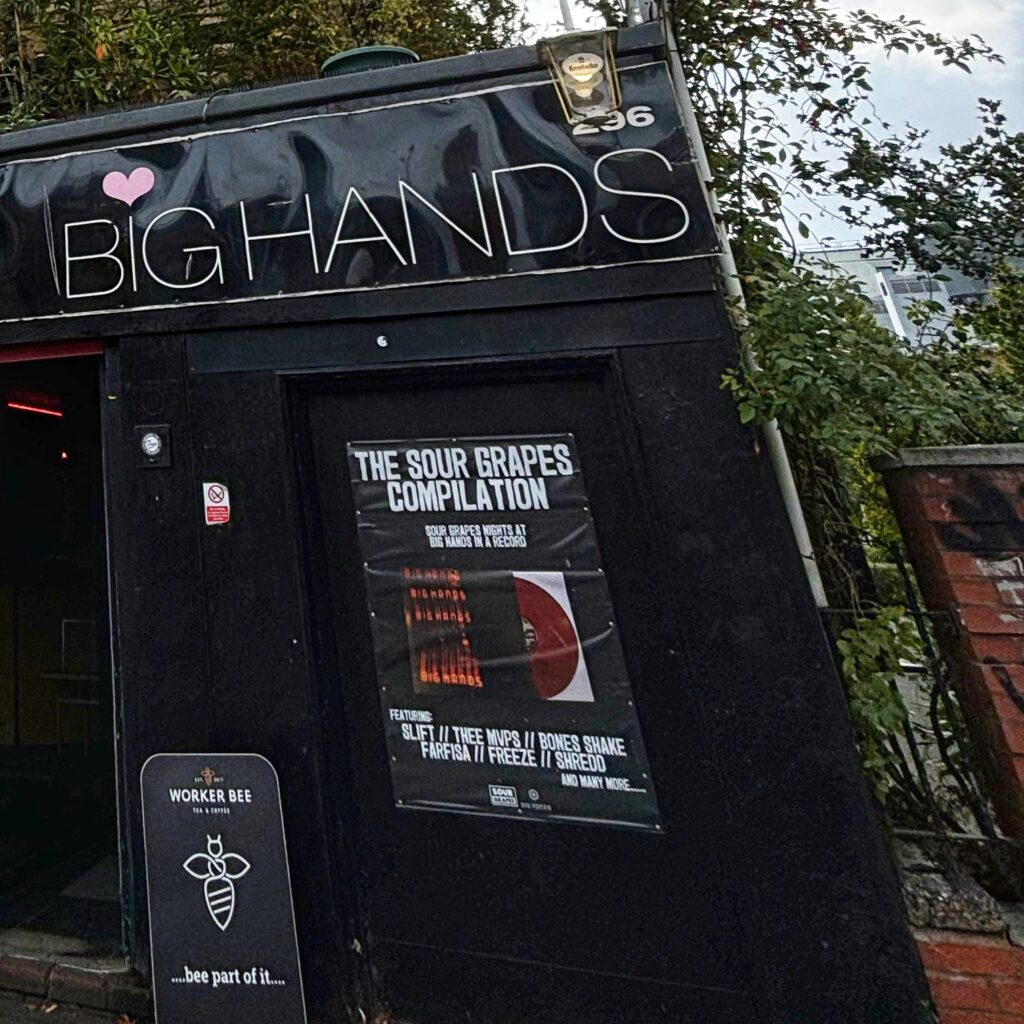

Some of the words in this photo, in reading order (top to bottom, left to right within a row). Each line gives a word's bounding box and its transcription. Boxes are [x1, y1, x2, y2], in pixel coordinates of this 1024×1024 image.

[354, 450, 401, 481] THE
[405, 447, 470, 479] SOUR
[474, 444, 574, 478] GRAPES
[387, 477, 550, 512] COMPILATION
[425, 525, 447, 537] SOUR
[449, 525, 481, 536] GRAPES
[483, 524, 513, 536] NIGHTS
[515, 524, 527, 536] AT
[429, 536, 444, 548] BIG
[445, 536, 472, 548] HANDS
[474, 536, 484, 547] IN
[493, 536, 527, 548] RECORD
[389, 708, 433, 723] FEATURING:
[401, 724, 435, 741] SLIFT
[452, 726, 485, 745] THEE
[486, 728, 520, 747] MVPS
[538, 732, 580, 753] BONES
[583, 735, 627, 756] SHAKE
[421, 743, 471, 762] FARFISA
[488, 747, 537, 767] FREEZE
[555, 752, 606, 773] SHREDD
[561, 774, 577, 787] AND
[580, 775, 604, 789] MANY
[169, 788, 226, 803] WORKER
[228, 789, 252, 803] BEE
[211, 969, 241, 988] part
[243, 967, 257, 985] of
